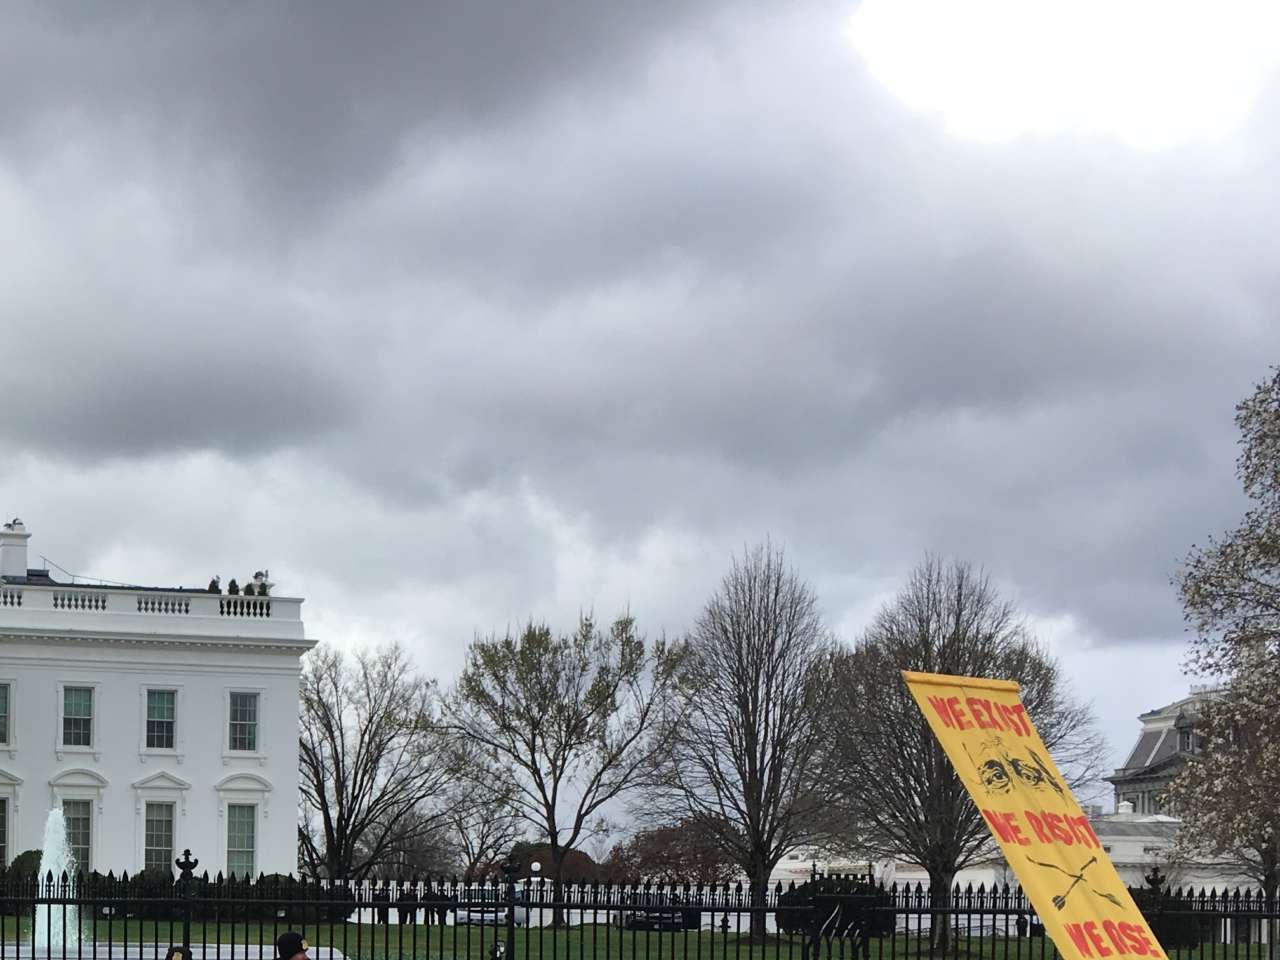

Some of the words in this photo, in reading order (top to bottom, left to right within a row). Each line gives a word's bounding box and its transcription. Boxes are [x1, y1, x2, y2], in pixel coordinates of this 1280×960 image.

[927, 694, 974, 731] WE
[982, 809, 1031, 846] WE
[1063, 921, 1114, 959] WE
